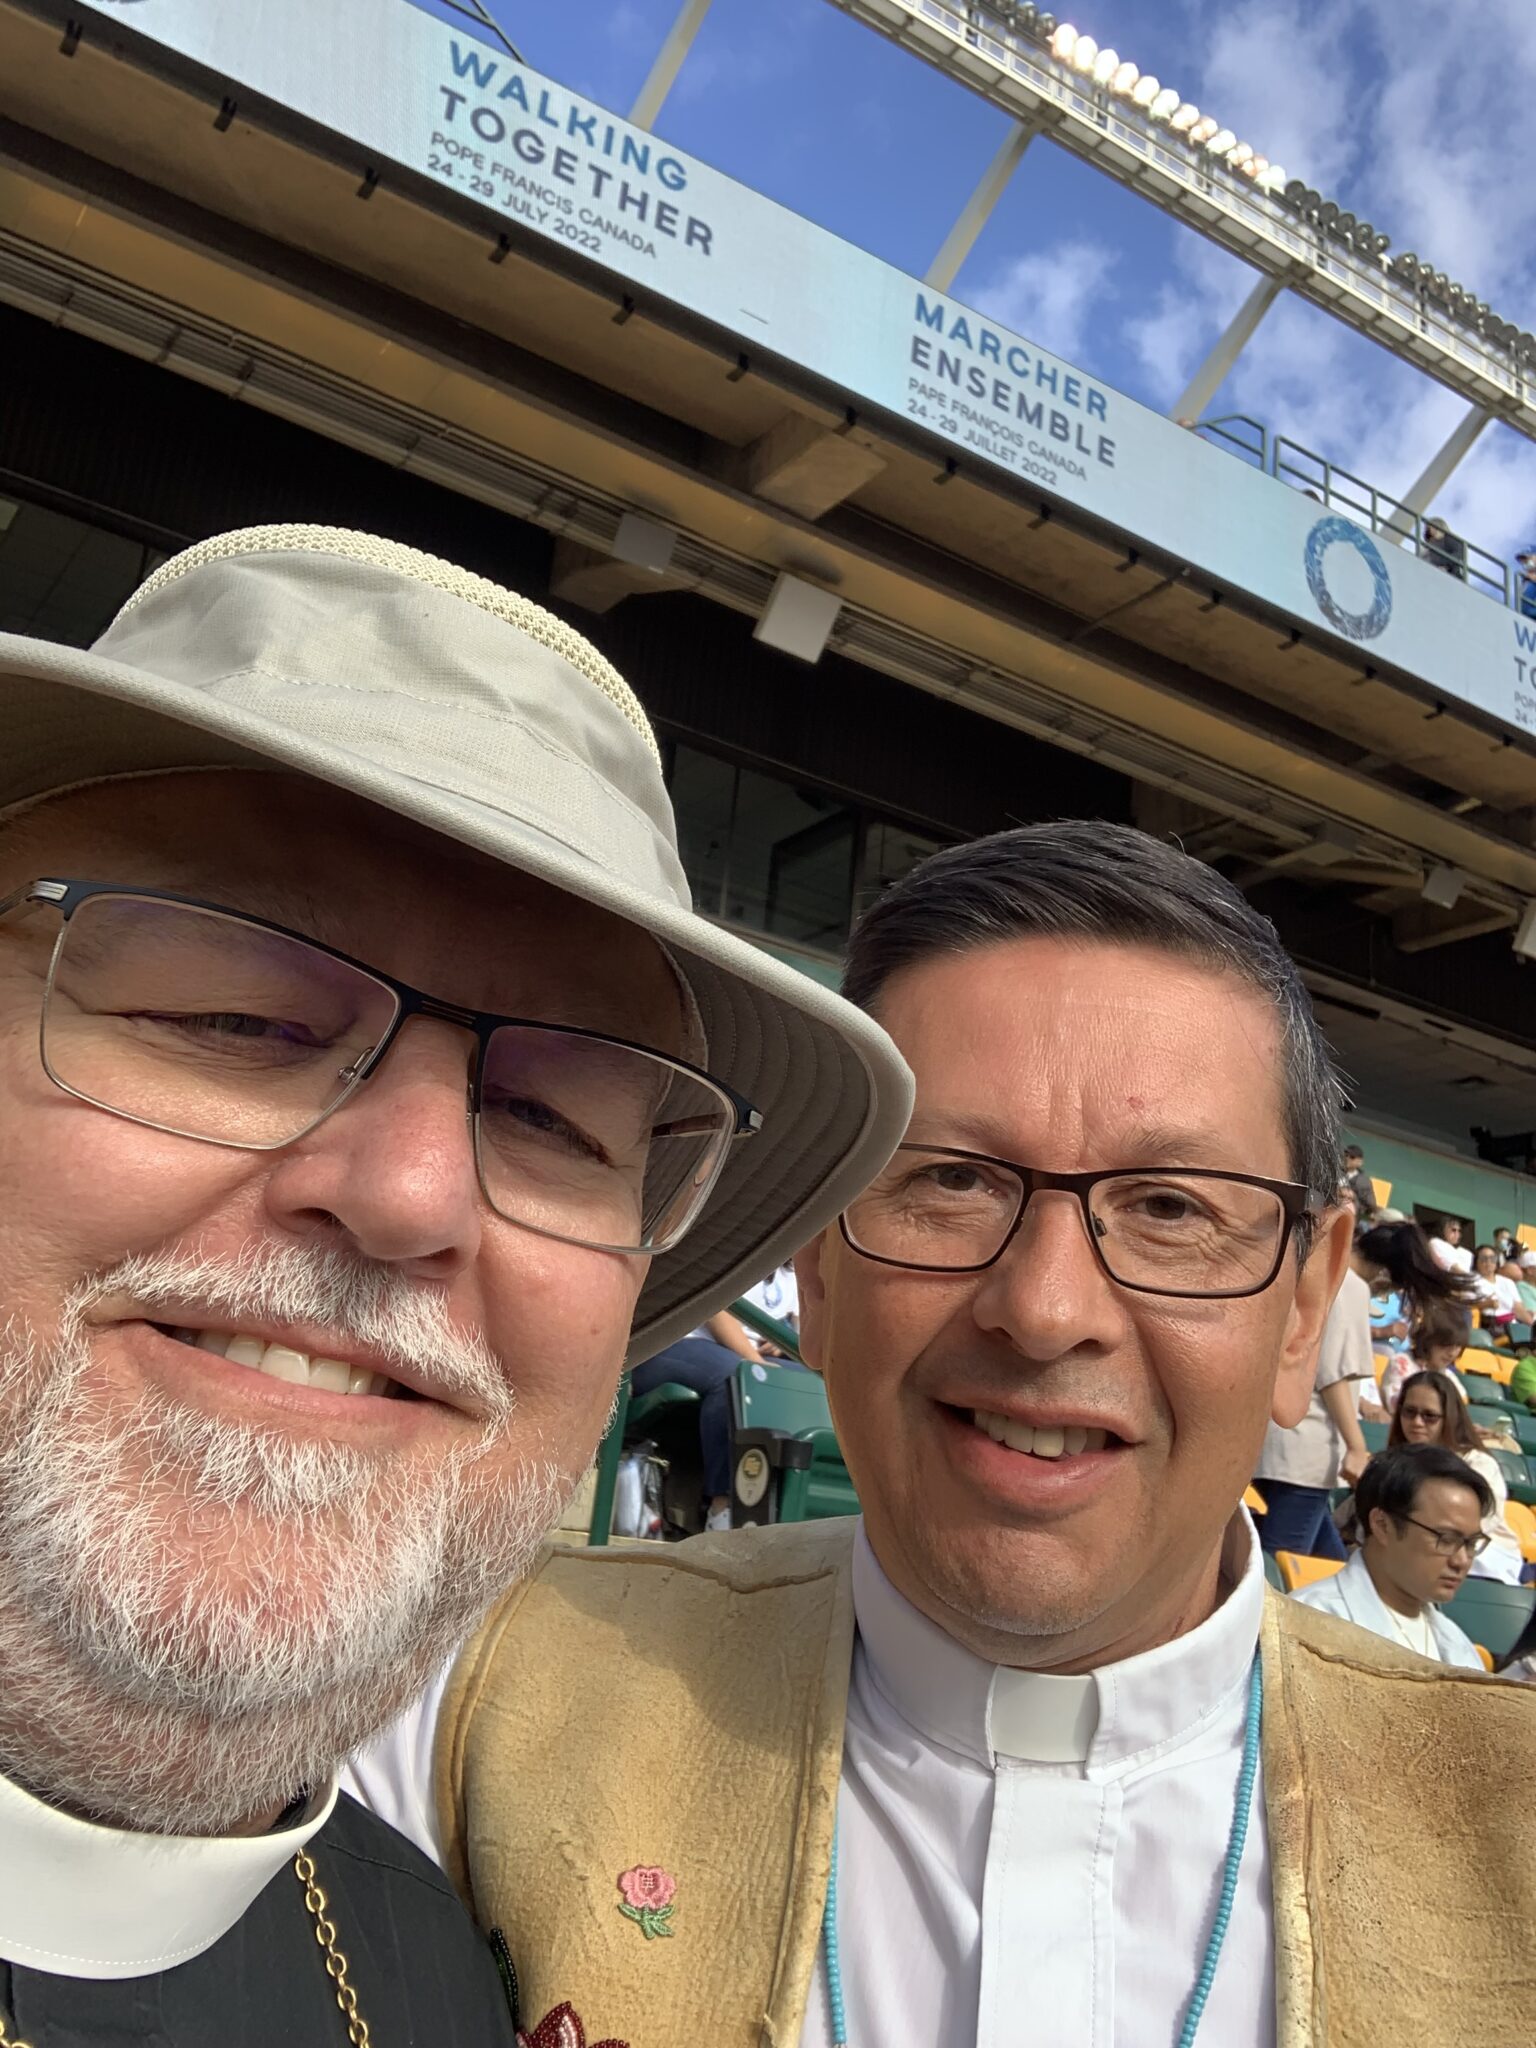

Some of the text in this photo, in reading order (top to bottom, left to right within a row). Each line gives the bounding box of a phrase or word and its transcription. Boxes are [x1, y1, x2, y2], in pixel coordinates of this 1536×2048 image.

[440, 86, 714, 256] TOGETHER
[450, 40, 688, 191] WALKING
[428, 154, 453, 177] 24
[469, 176, 494, 198] 29
[501, 193, 549, 224] JULY
[554, 218, 601, 253] 2022
[431, 132, 657, 259] POPE FRANCIS CANADA
[910, 335, 1116, 468] ENSEMBLE
[915, 293, 1107, 422] MARCHER
[907, 399, 928, 418] 24
[939, 415, 958, 434] 29
[963, 429, 1018, 464] JUILLET
[1021, 457, 1057, 485] 2022
[908, 377, 1087, 481] PAPE FRANÇOIS CANADA
